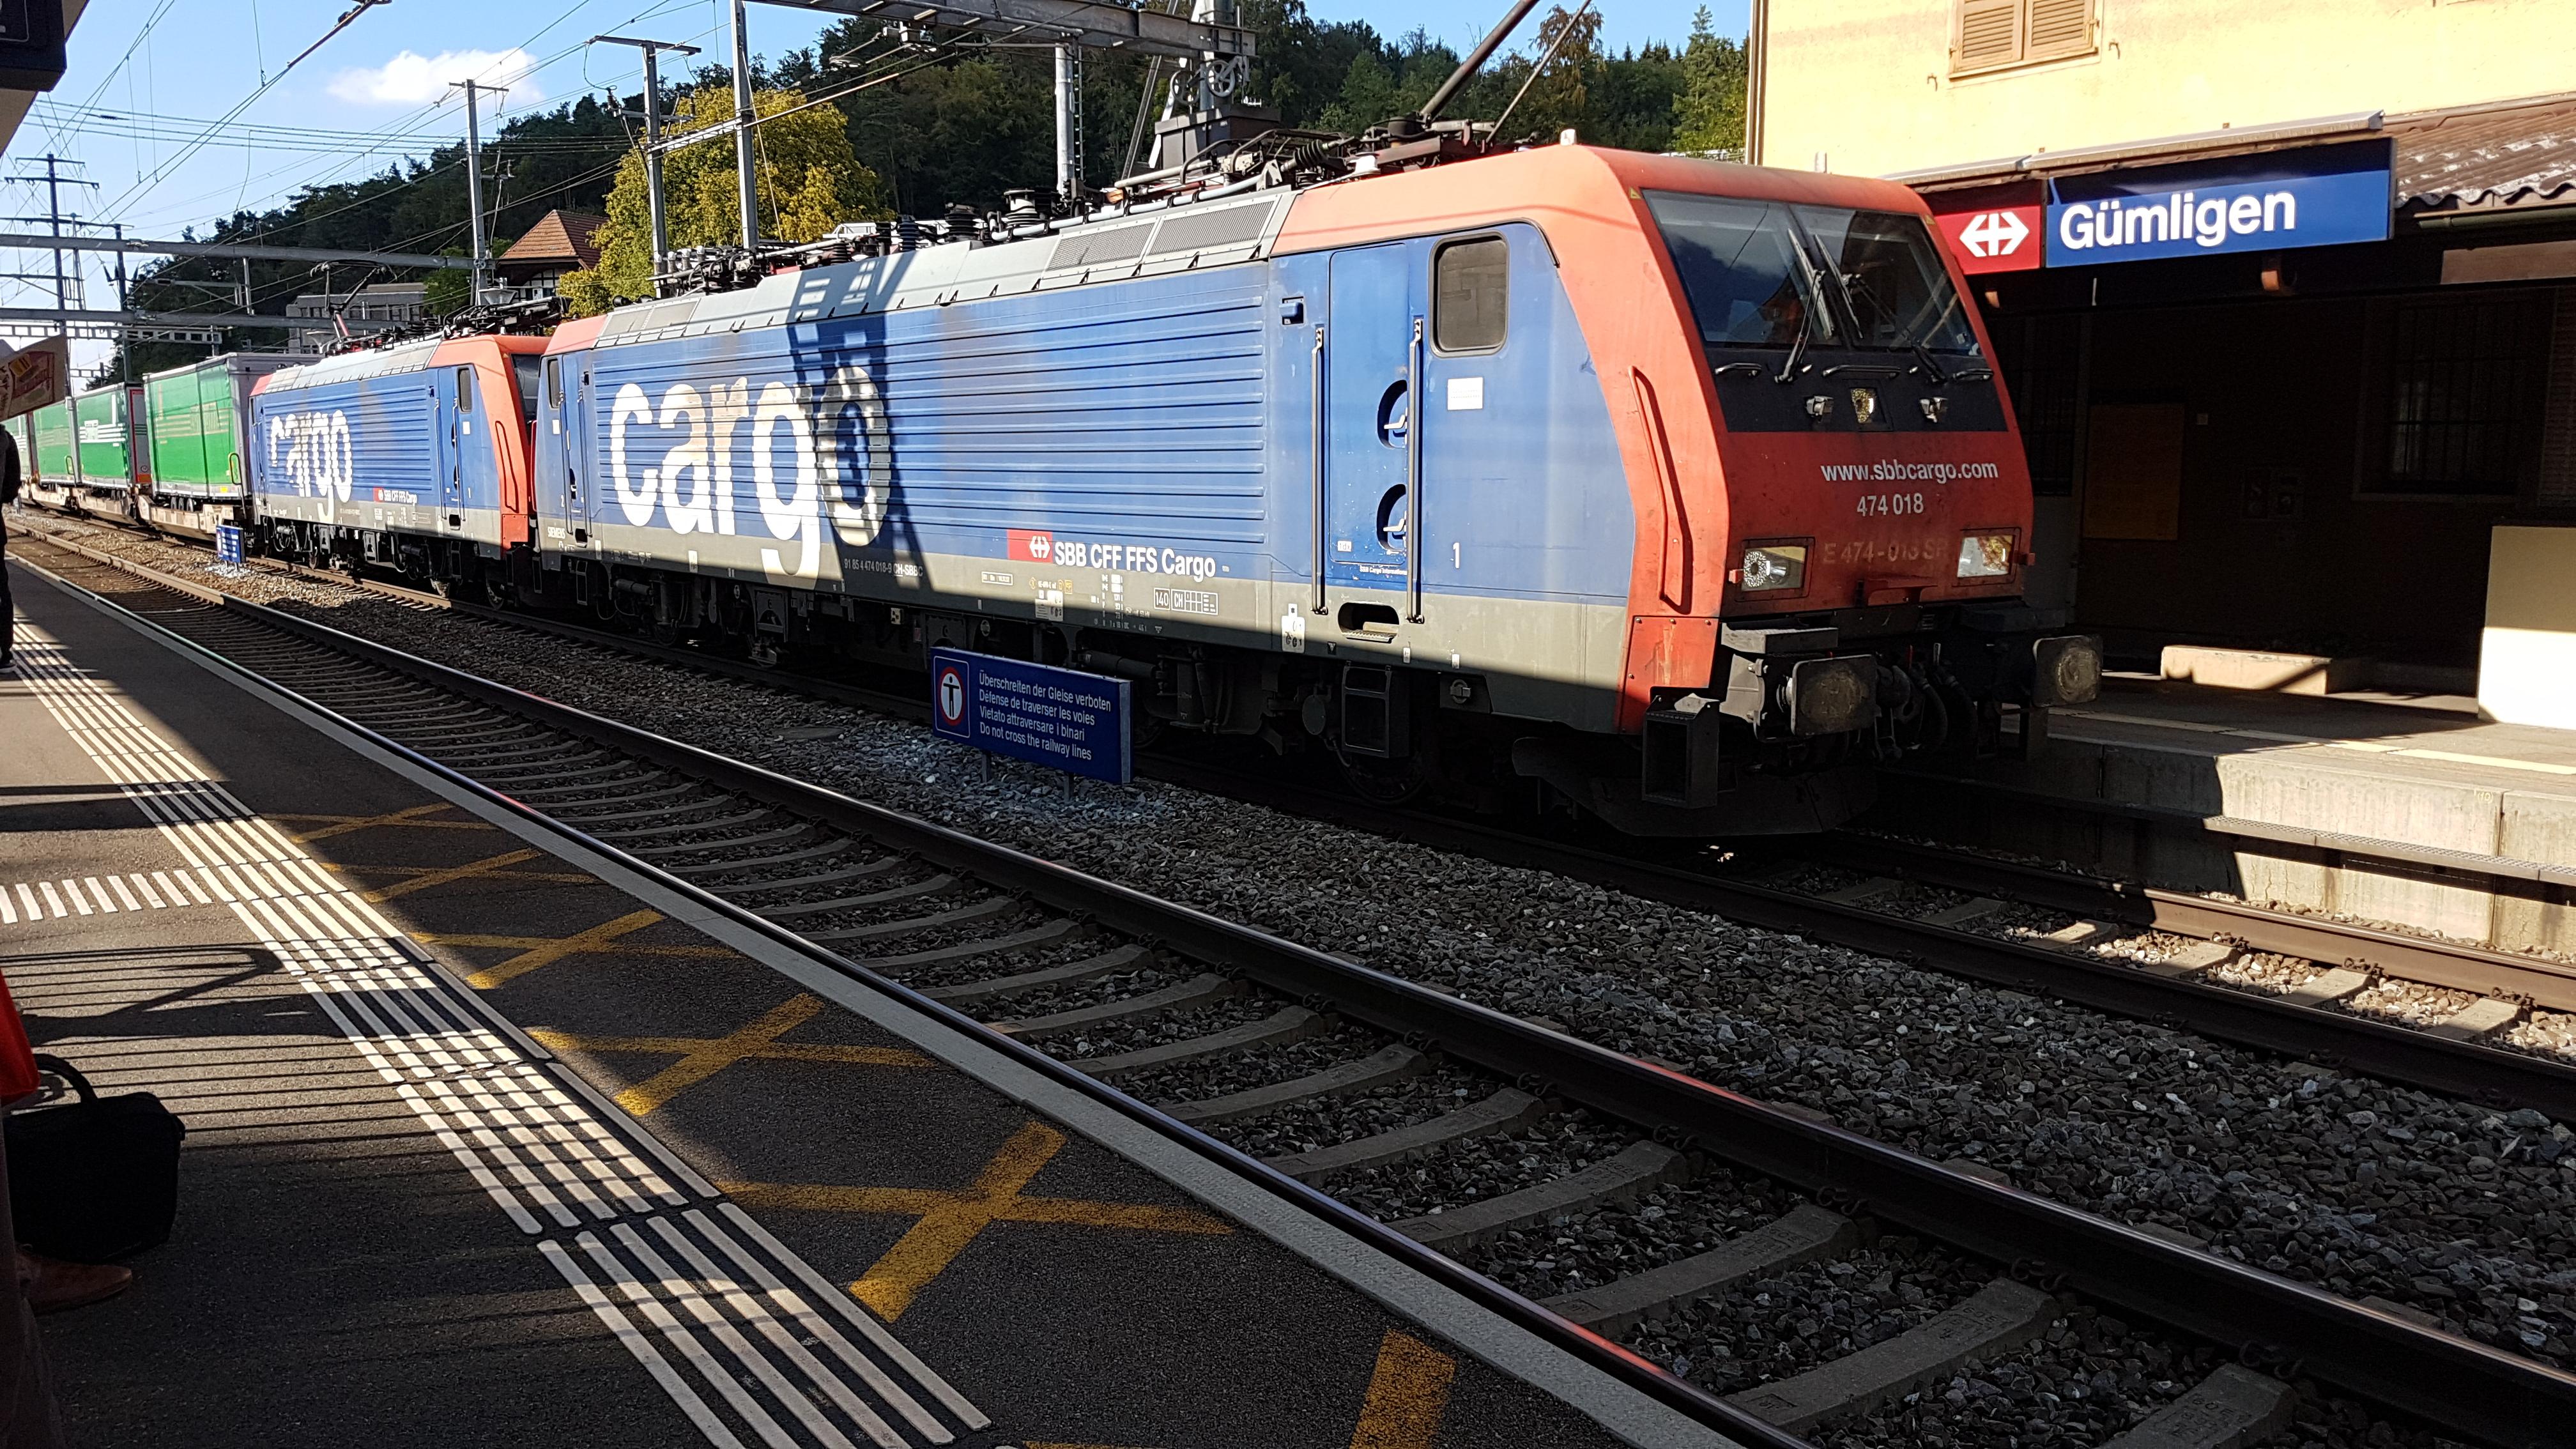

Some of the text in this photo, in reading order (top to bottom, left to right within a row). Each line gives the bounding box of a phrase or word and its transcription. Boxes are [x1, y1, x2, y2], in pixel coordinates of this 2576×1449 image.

[2060, 190, 2296, 250] Gümligen
[270, 410, 353, 525] cargo
[610, 366, 892, 592] cargo
[1821, 459, 1999, 484] www.sbbcargo.com
[1857, 493, 1924, 516] 474 018
[548, 526, 566, 539] SIEMENS
[845, 558, 923, 577] 91 85 4 474 018-9 CH-SBBC
[1055, 541, 1216, 583] SBB CFF FFS Cargo
[1453, 542, 1460, 569] 1
[1155, 592, 1183, 608] 140 CH
[979, 670, 1111, 712] Überschreiten der Gleise verboten
[979, 689, 1095, 726] Défense de traverser les voies
[979, 705, 1085, 741] Vietato attraversare i binari
[979, 722, 1092, 760] Do not cross the railway lines
